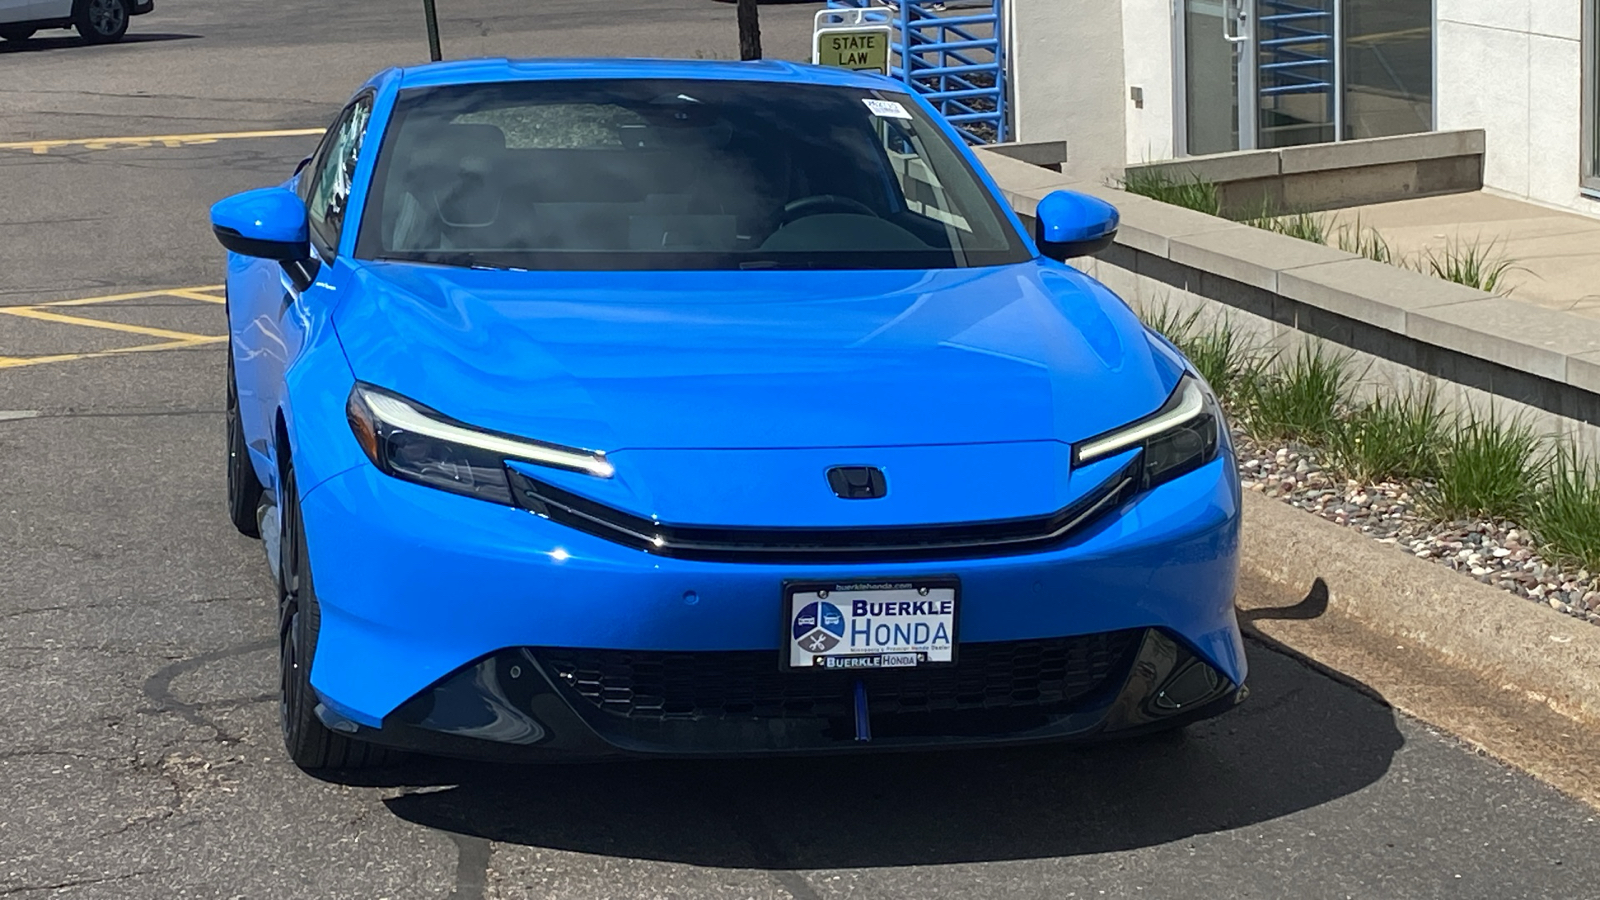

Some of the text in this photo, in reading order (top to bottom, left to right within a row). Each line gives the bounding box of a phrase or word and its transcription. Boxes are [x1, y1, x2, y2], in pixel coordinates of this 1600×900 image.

[833, 36, 875, 50] STATE
[839, 52, 868, 65] LAW
[835, 583, 912, 591] buerklehonda.com
[852, 599, 952, 617] BUERKLE
[851, 618, 950, 647] HONDA
[826, 654, 915, 668] BUERKLE HONDA
